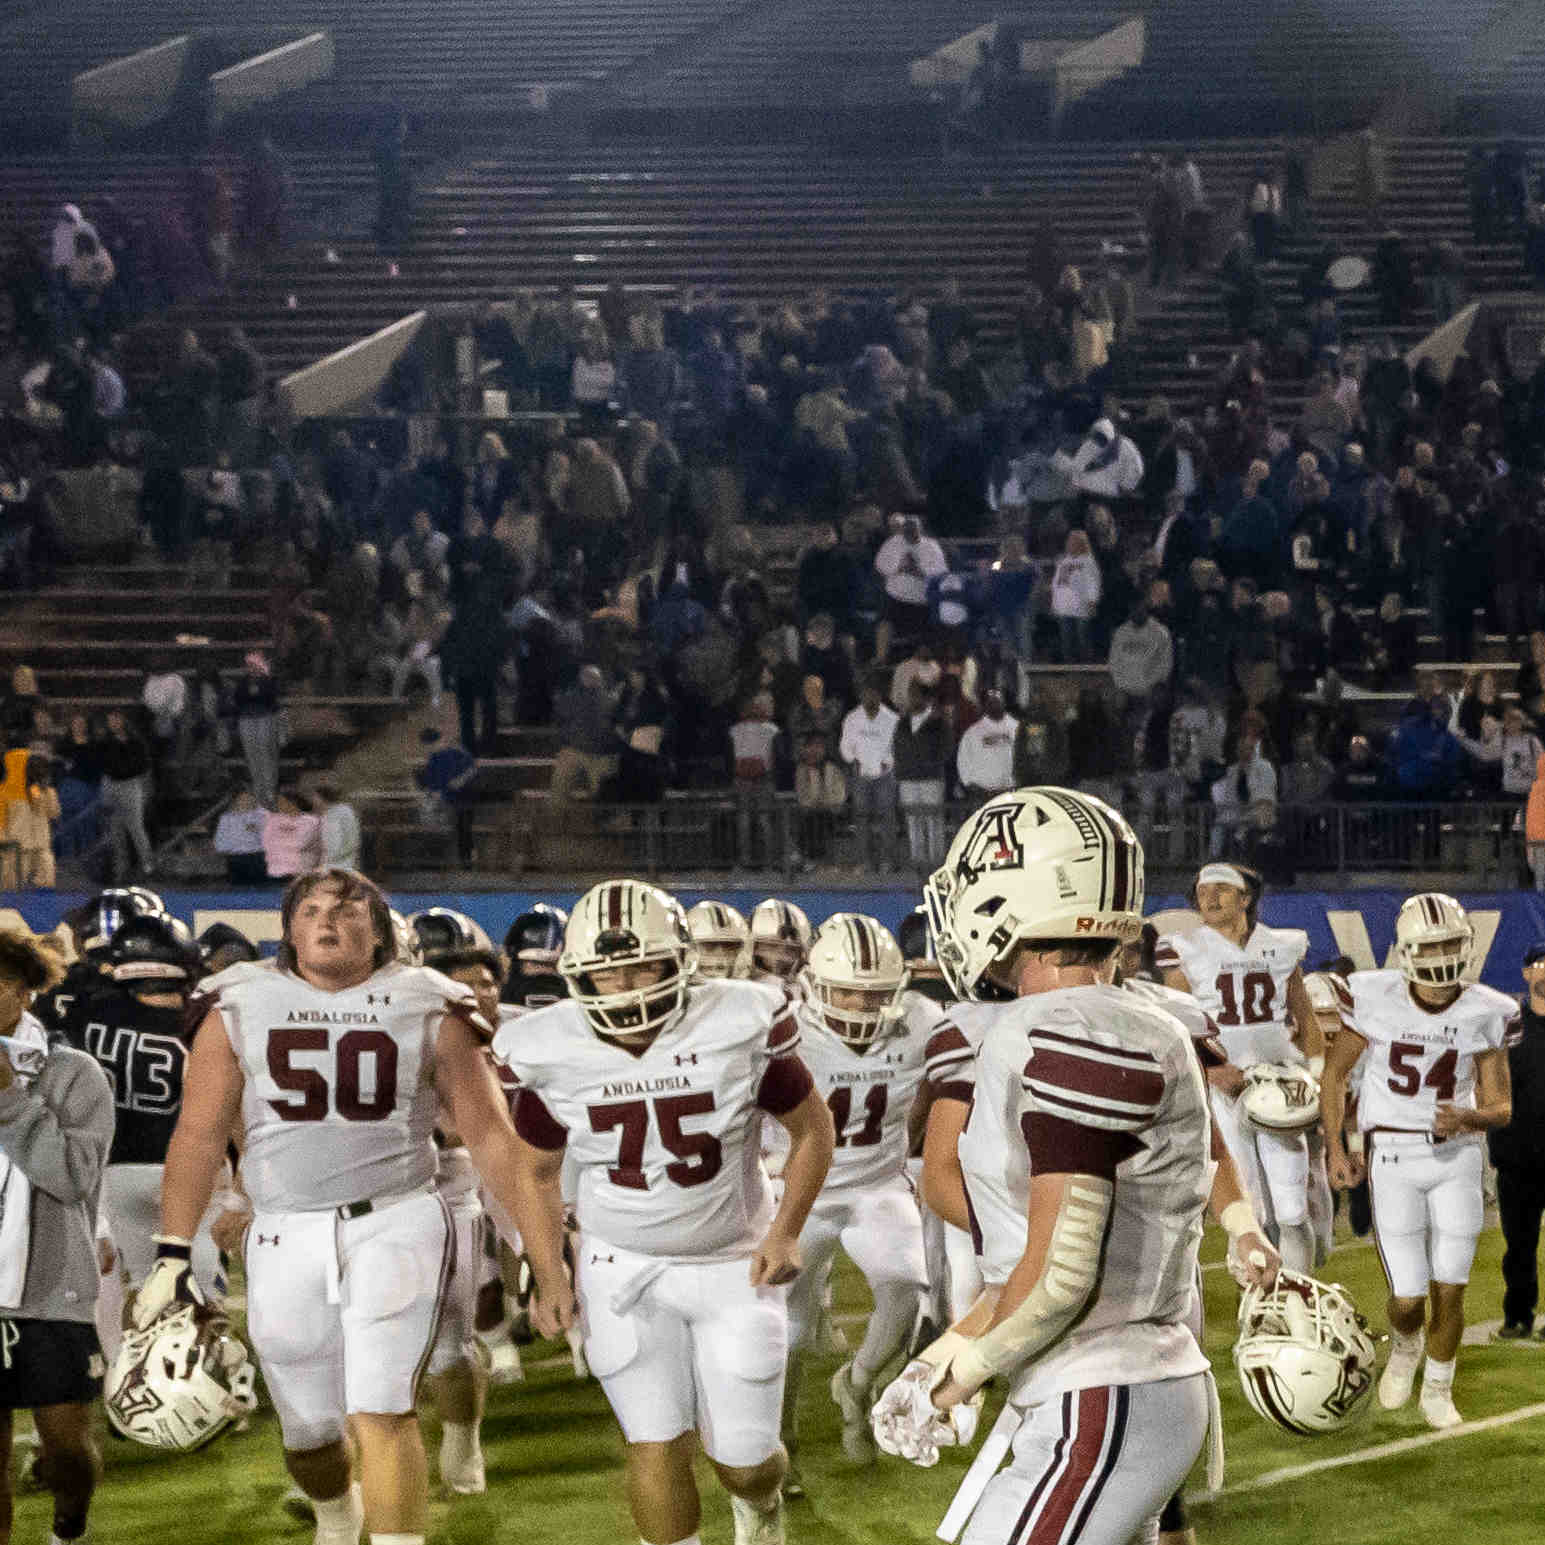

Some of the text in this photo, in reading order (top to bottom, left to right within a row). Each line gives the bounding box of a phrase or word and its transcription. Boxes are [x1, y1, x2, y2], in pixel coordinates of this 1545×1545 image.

[287, 1011, 379, 1025] ANDALUSIA
[1215, 972, 1276, 1025] 10
[85, 1023, 189, 1115] 43
[267, 1028, 398, 1122] 50
[602, 1075, 692, 1098] ANDALUSIA
[1388, 1041, 1459, 1100] 54
[586, 1090, 723, 1192] 75
[826, 1082, 889, 1148] 11
